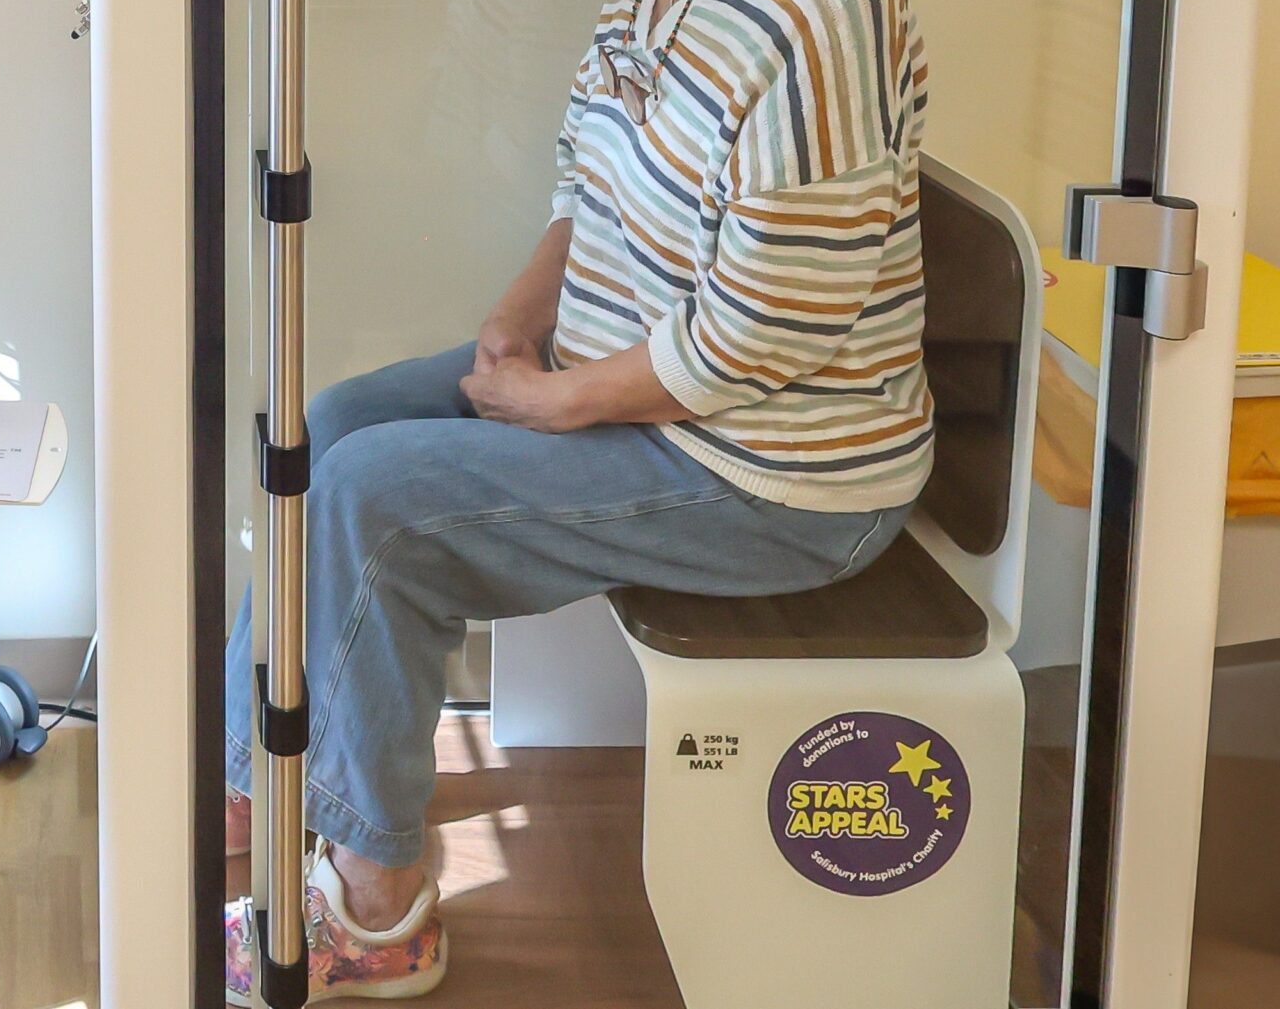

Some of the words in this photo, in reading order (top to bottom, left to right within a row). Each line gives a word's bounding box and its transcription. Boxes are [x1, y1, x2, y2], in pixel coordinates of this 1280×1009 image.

[703, 735, 723, 745] 250
[725, 735, 739, 746] kg
[798, 722, 840, 756] Funded
[839, 720, 855, 733] by
[802, 732, 854, 768] donations
[856, 727, 869, 741] to
[703, 748, 722, 756] 551
[725, 748, 738, 756] LB
[689, 760, 724, 770] MAX
[790, 784, 888, 809] STARS
[788, 811, 907, 836] APPEAL
[811, 849, 857, 882] Salisbury
[858, 861, 914, 882] Hospital's
[912, 829, 944, 864] Charity
